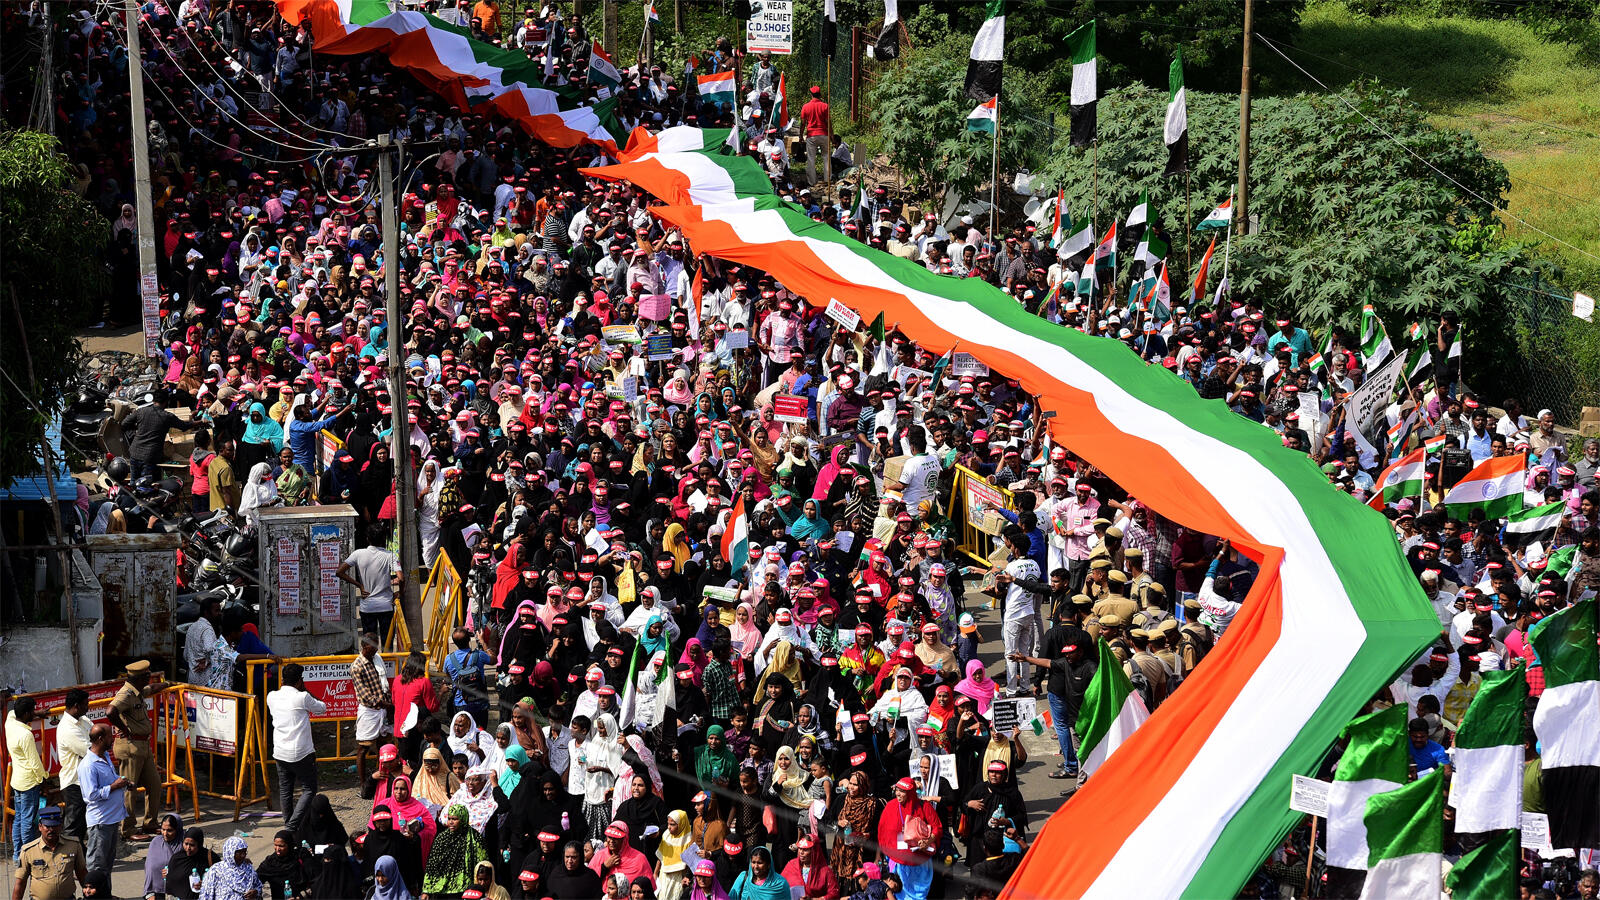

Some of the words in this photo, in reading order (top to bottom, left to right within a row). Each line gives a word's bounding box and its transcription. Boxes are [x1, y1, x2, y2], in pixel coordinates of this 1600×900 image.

[767, 2, 787, 10] WEAR
[764, 13, 791, 21] HELMET
[748, 23, 791, 32] C.D.SHOES
[322, 681, 347, 699] Nalli
[201, 694, 227, 713] GRT
[86, 711, 107, 719] IPLICA
